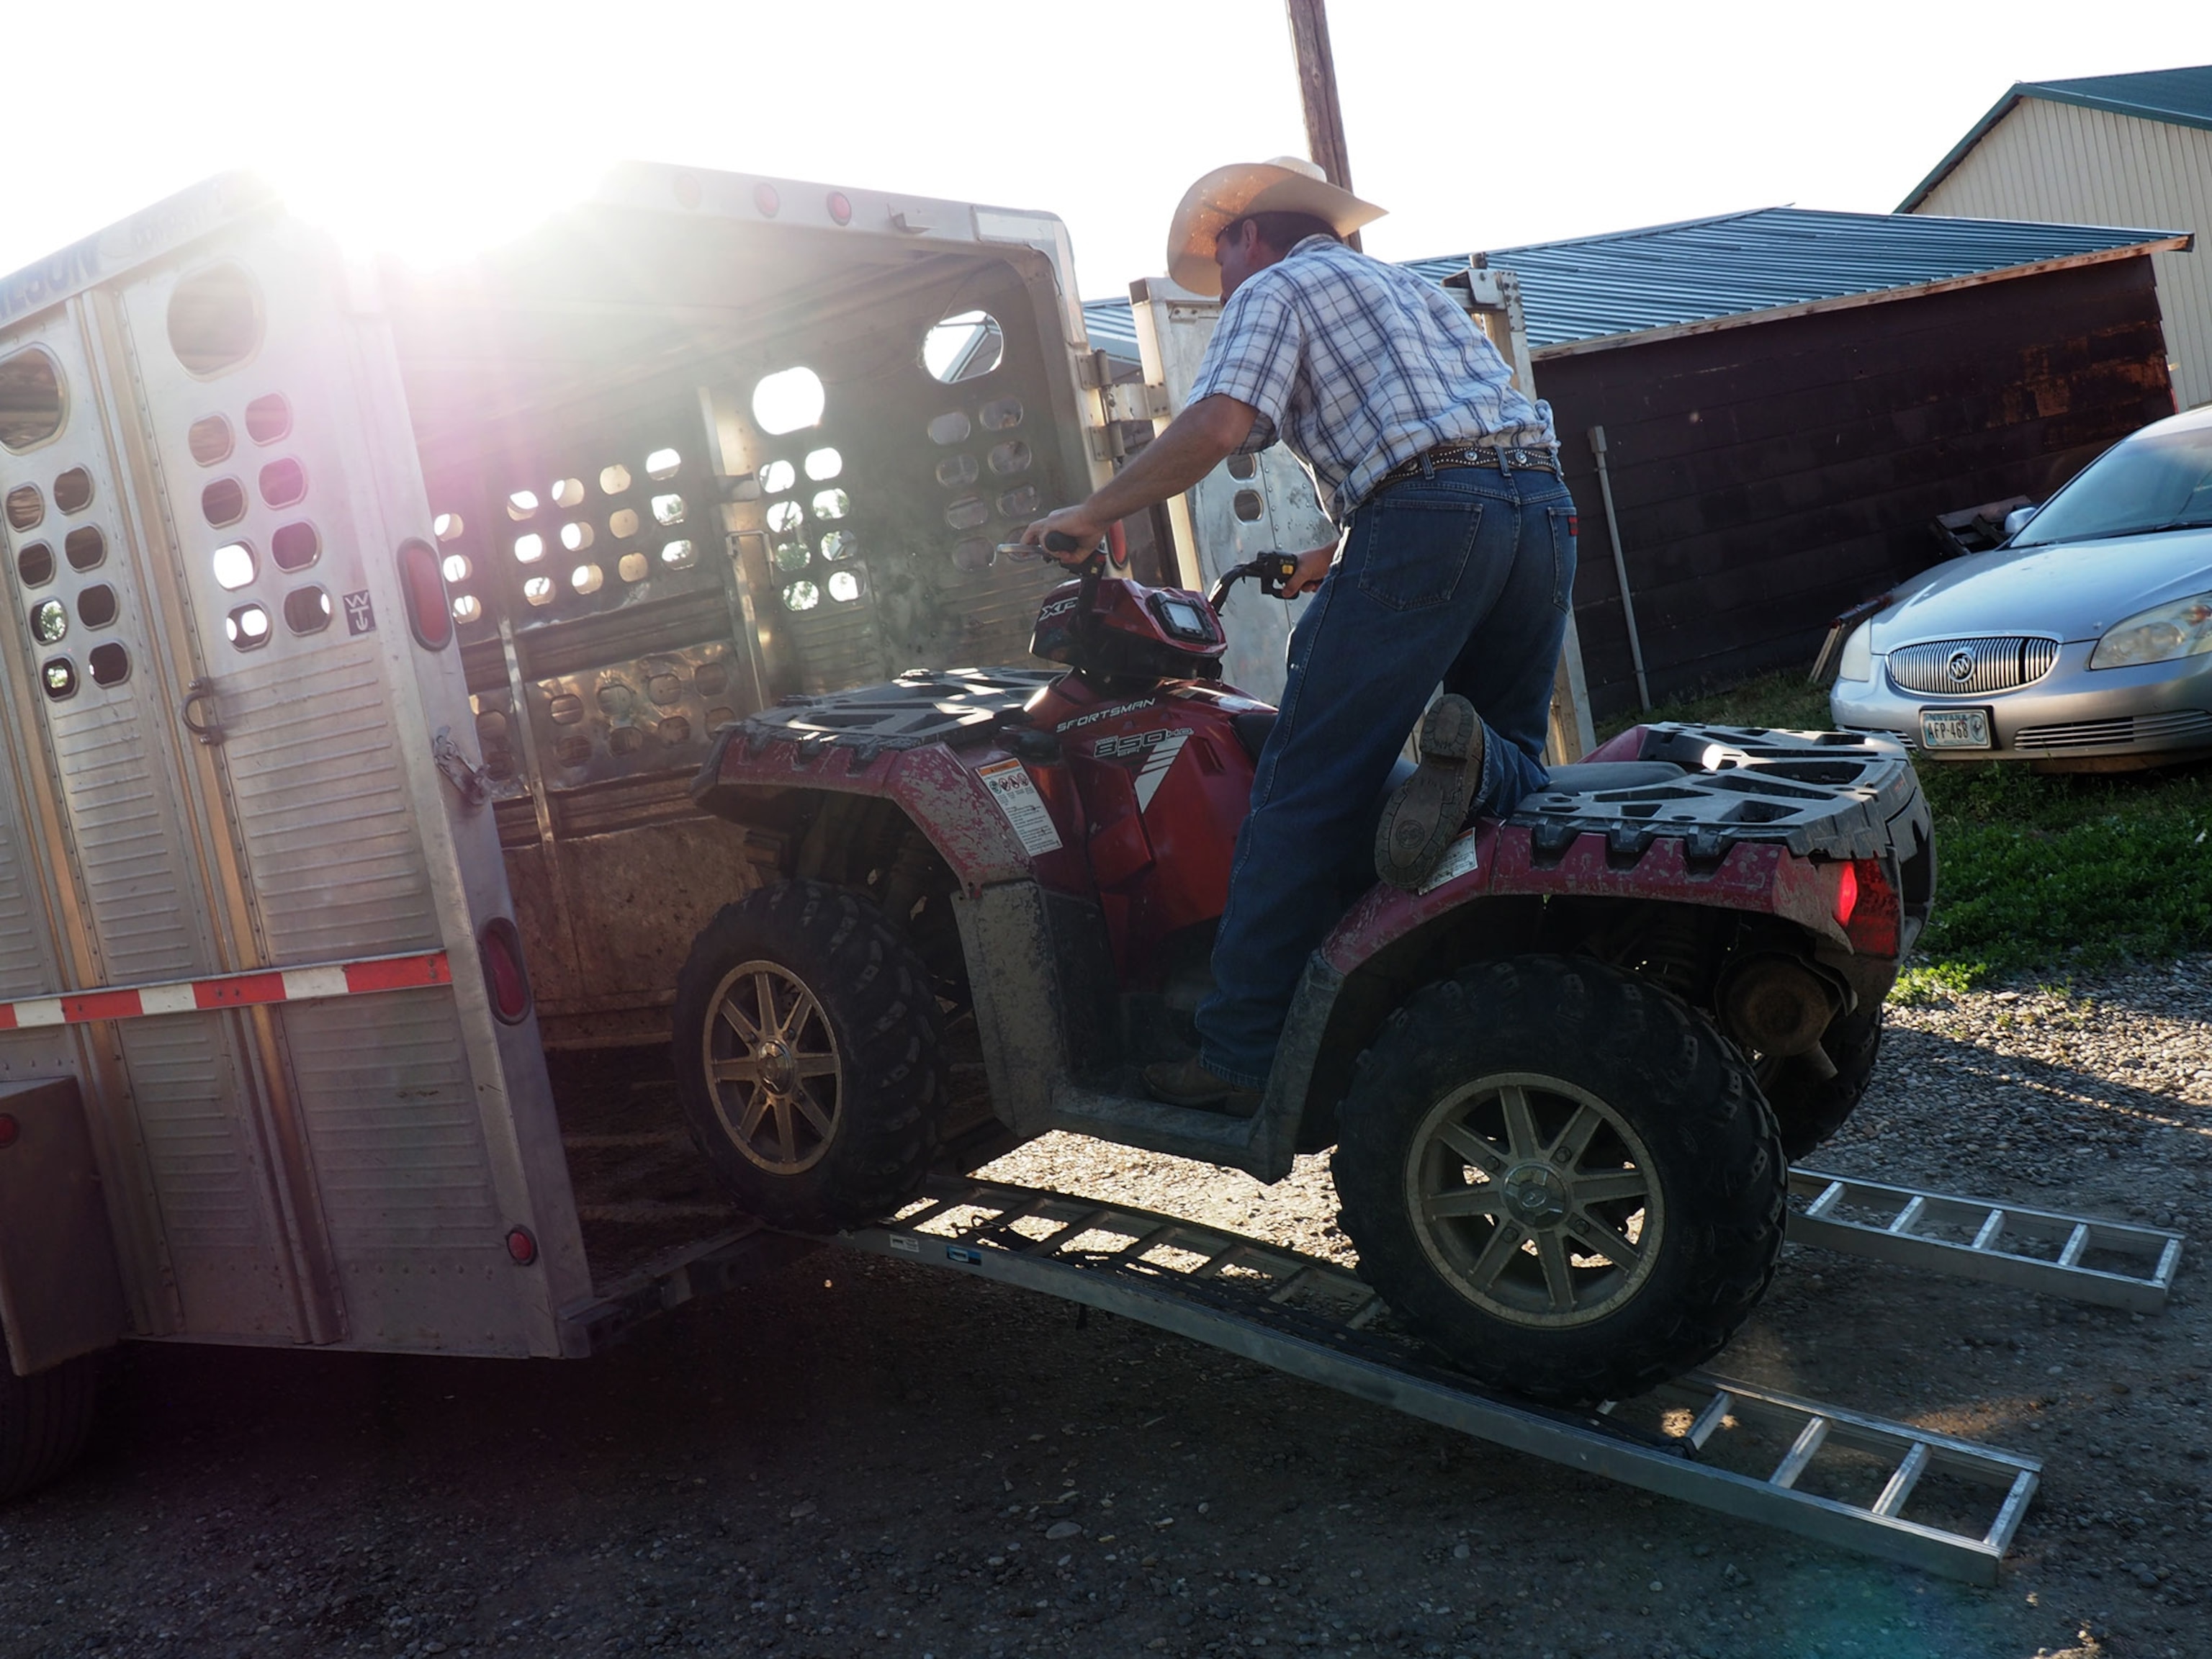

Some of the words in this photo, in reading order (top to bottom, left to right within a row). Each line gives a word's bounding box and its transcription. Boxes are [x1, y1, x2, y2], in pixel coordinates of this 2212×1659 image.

[1038, 596, 1079, 622] XP
[1056, 696, 1156, 734] SPORTSMAN
[1094, 729, 1168, 757] 850
[1928, 722, 1969, 739] AFP-468
